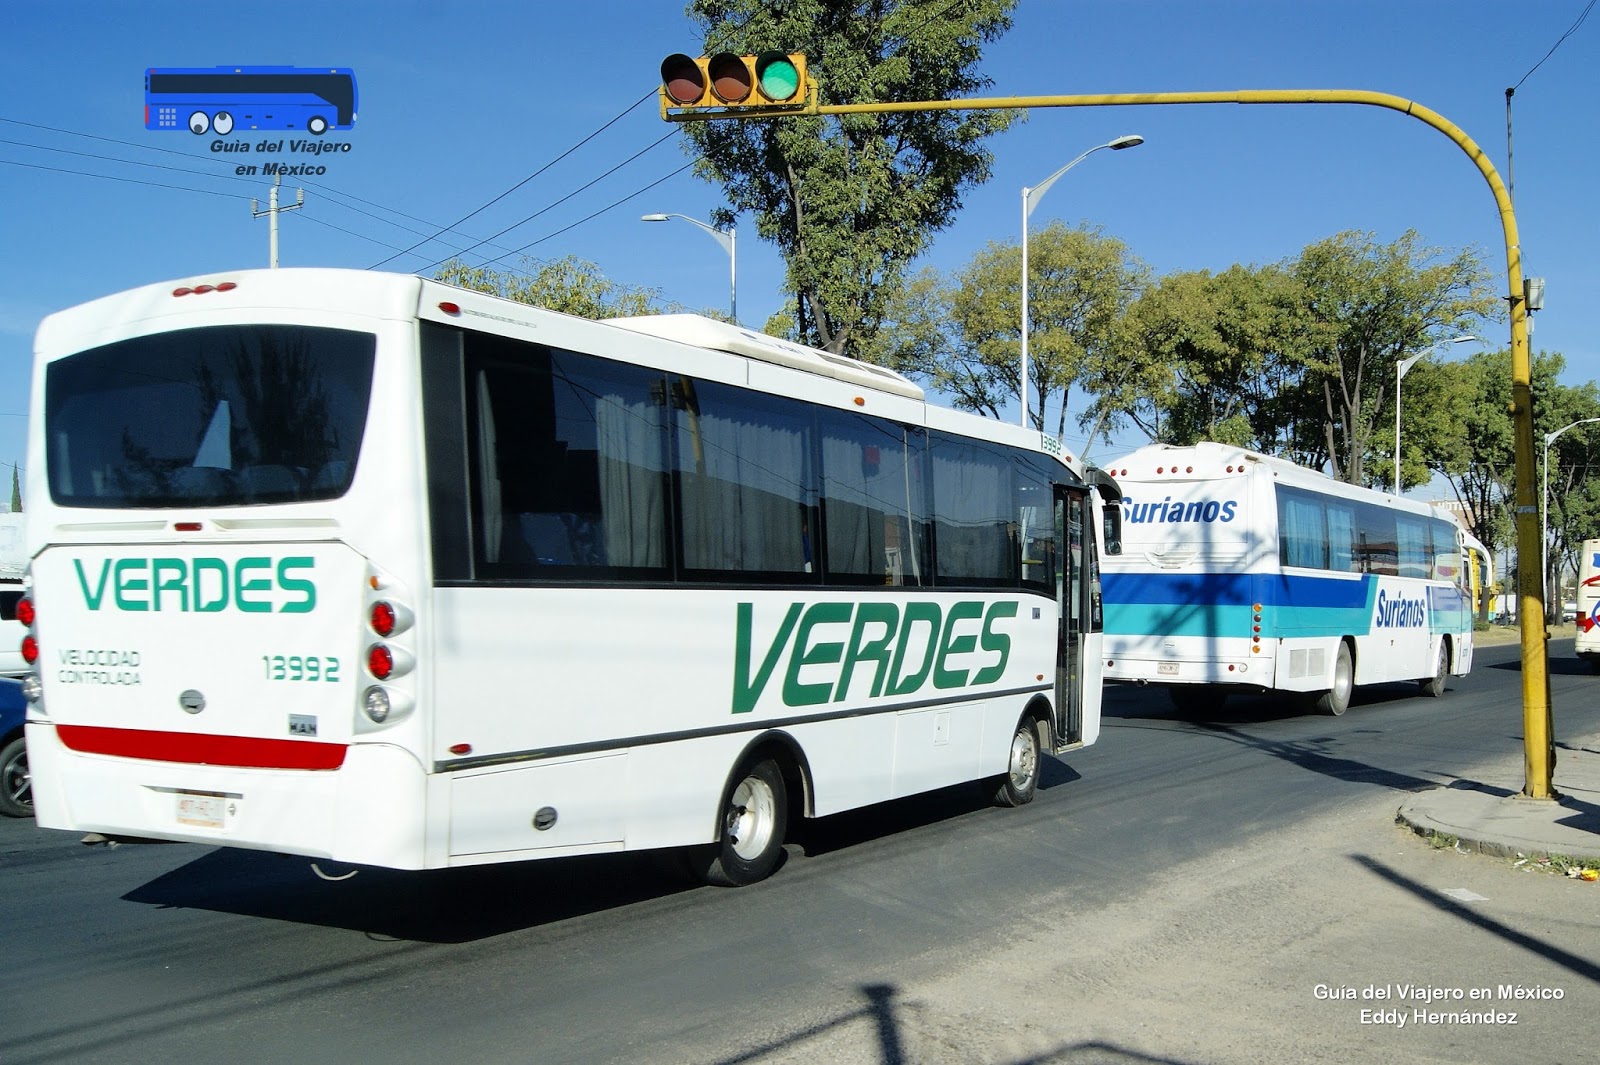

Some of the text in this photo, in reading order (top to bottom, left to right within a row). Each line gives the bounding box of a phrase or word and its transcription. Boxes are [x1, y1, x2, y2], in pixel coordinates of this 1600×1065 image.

[73, 556, 317, 614] VERDES
[1376, 589, 1426, 628] Surianos
[58, 649, 140, 667] VELOCIDAD
[262, 655, 341, 682] 13992
[731, 600, 1020, 714] VERDES
[59, 669, 142, 686] CONTROLADA
[289, 722, 317, 735] MAN
